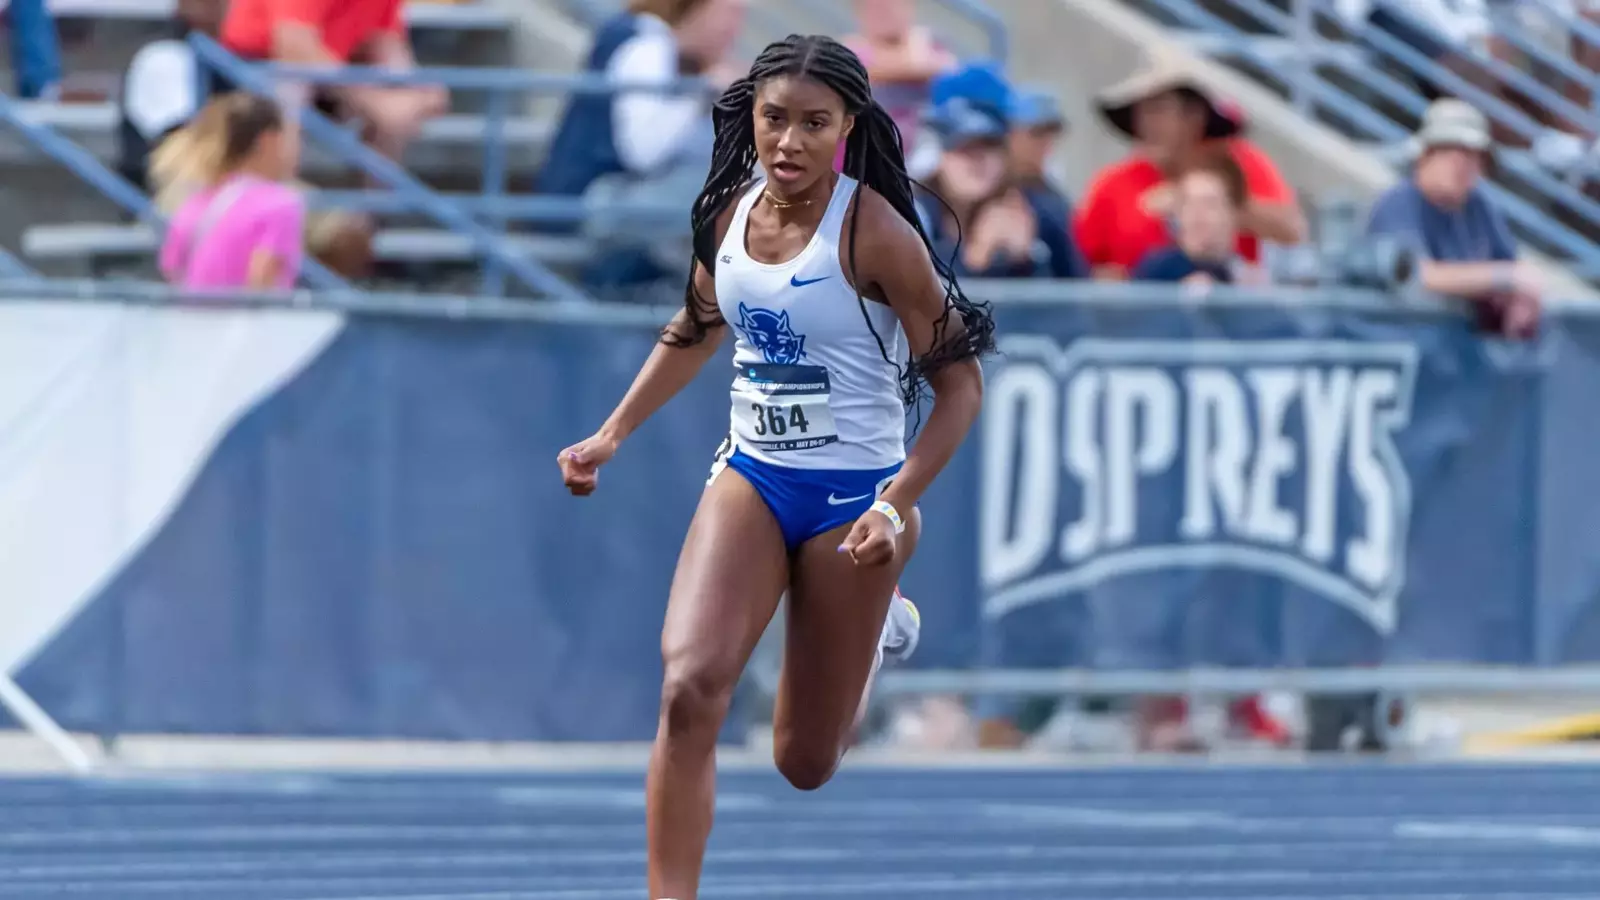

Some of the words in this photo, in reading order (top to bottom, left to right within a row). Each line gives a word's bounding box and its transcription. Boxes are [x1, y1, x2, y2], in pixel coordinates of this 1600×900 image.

[751, 403, 809, 436] 364
[796, 440, 809, 449] MAY
[981, 366, 1398, 586] OSPREYS
